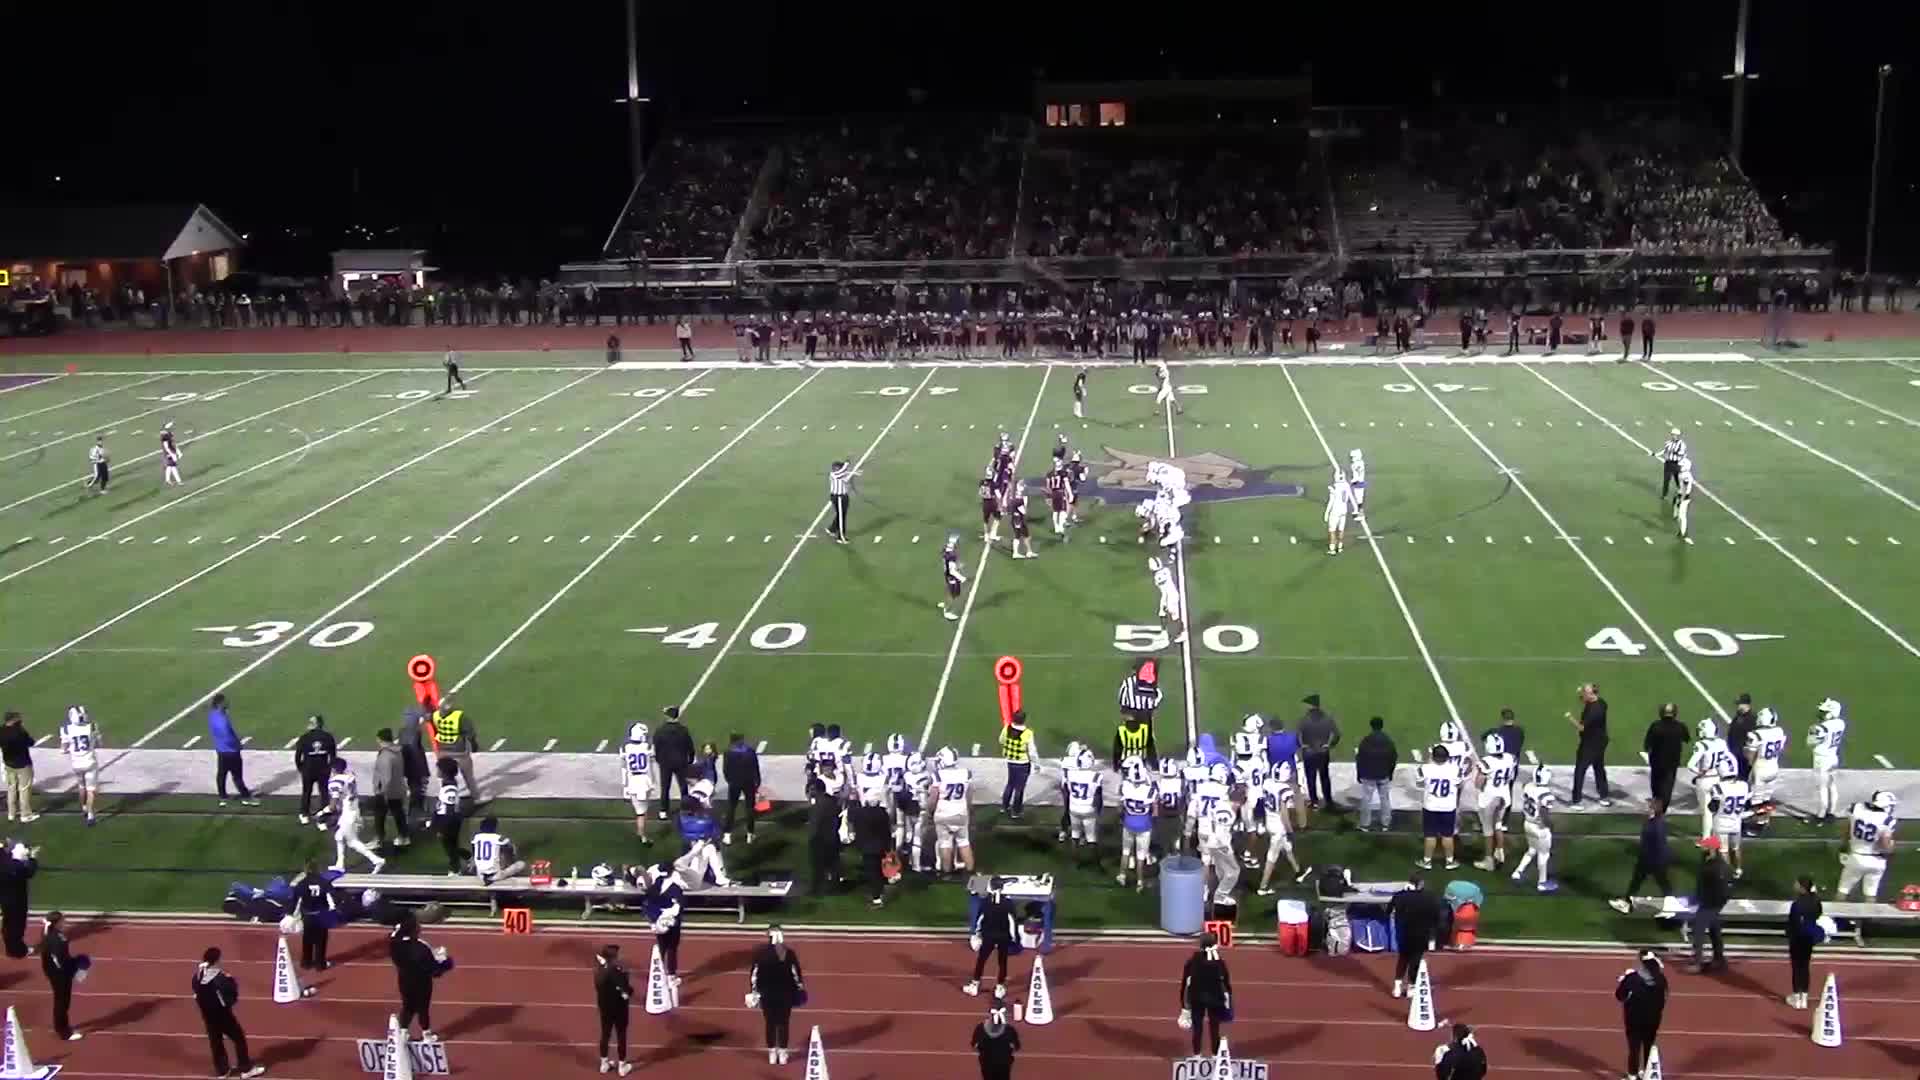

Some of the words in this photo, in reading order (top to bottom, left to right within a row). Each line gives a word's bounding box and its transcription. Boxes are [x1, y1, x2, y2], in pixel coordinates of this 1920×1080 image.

[223, 621, 375, 648] 30
[661, 622, 807, 649] 40
[1113, 625, 1260, 652] 50
[1585, 627, 1739, 656] 40
[71, 735, 90, 752] 13
[628, 753, 648, 771] 20
[944, 783, 966, 800] 79
[1071, 782, 1089, 801] 57
[1430, 779, 1451, 797] 78
[1723, 796, 1745, 815] 35
[1853, 819, 1877, 843] 62
[476, 841, 493, 861] 10
[505, 911, 527, 934] 40
[653, 958, 663, 1006] EAGLES
[1032, 966, 1044, 1015] EAGLES
[1419, 971, 1430, 1021] EAGLES
[361, 1041, 447, 1073] OFNSE
